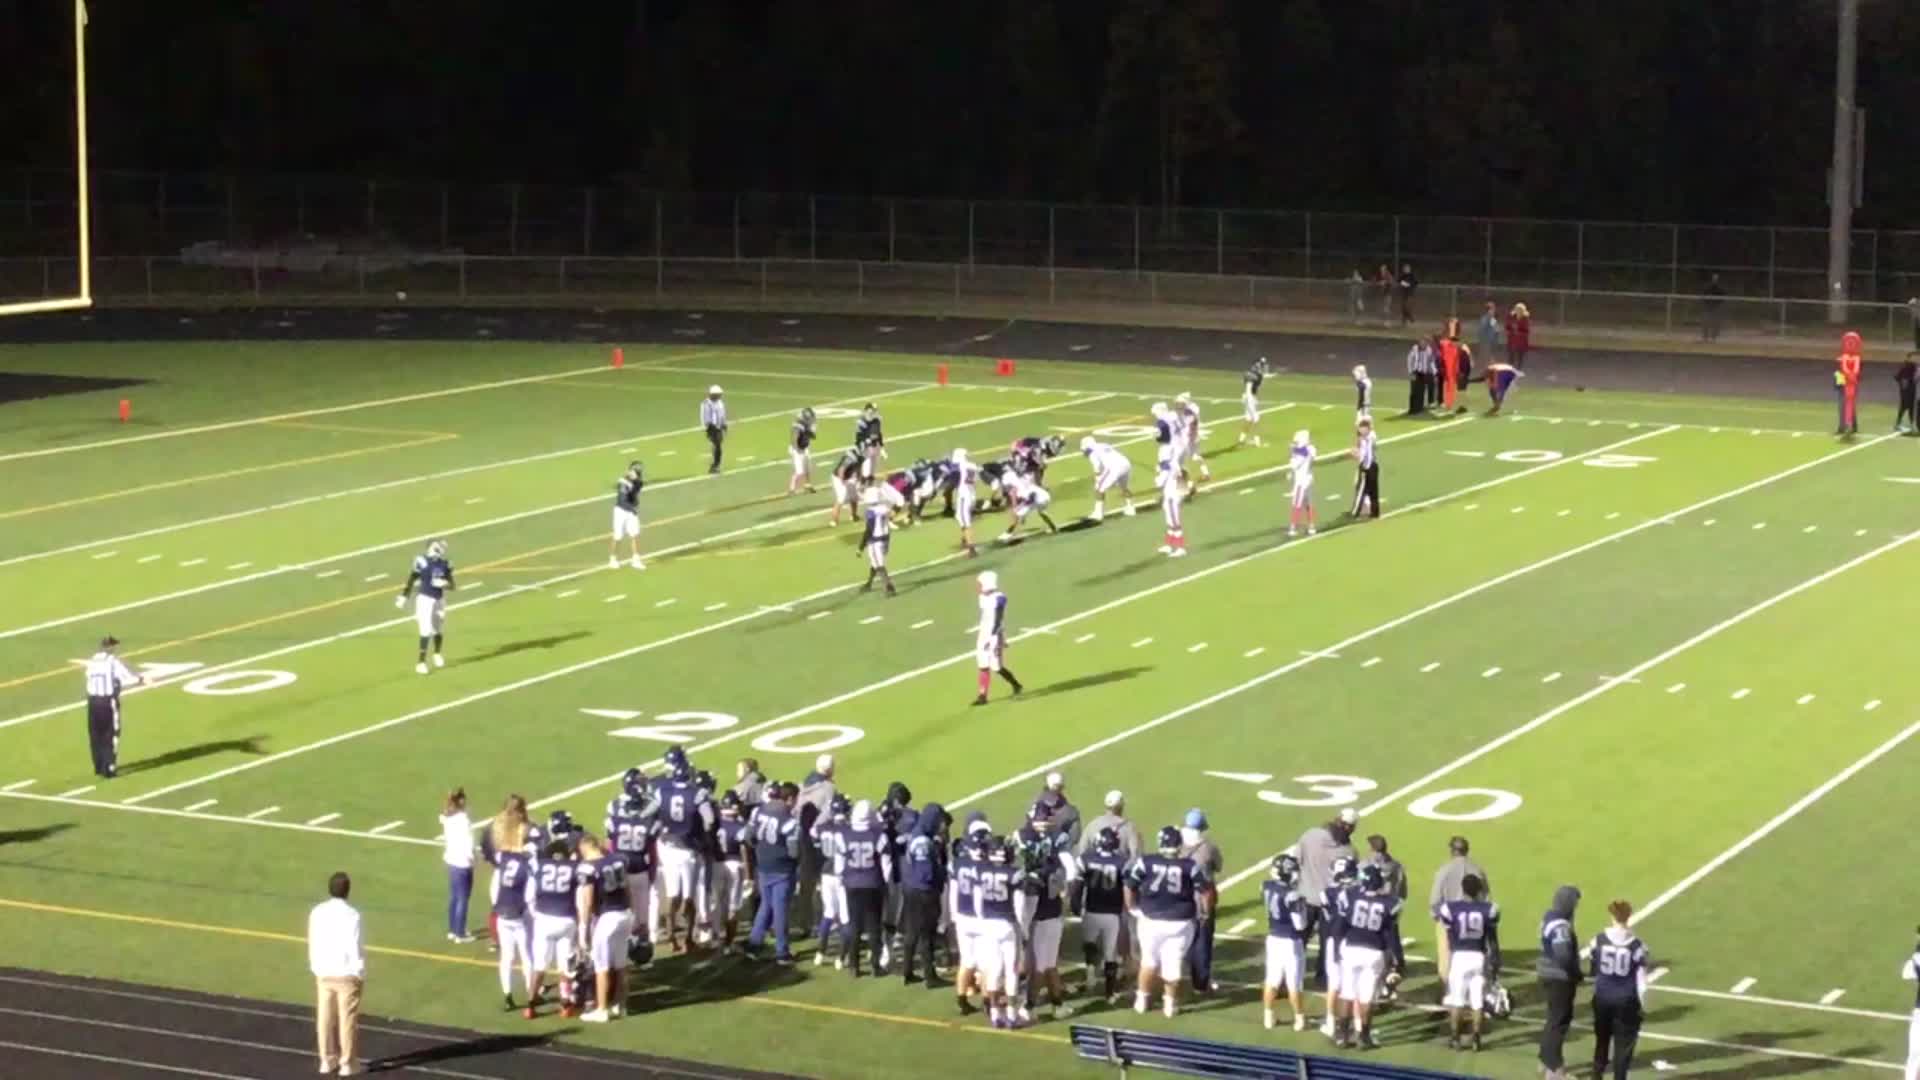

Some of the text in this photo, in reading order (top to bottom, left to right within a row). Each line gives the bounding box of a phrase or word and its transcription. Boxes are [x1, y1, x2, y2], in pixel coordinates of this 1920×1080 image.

[606, 711, 865, 753] 20
[669, 795, 685, 822] 6
[1256, 774, 1523, 821] 30
[617, 823, 647, 851] 26
[848, 841, 874, 868] 32
[502, 859, 520, 887] 2
[541, 863, 572, 893] 22
[1149, 864, 1182, 893] 79
[1352, 900, 1385, 931] 66
[1457, 911, 1484, 939] 19
[1600, 946, 1630, 976] 50
